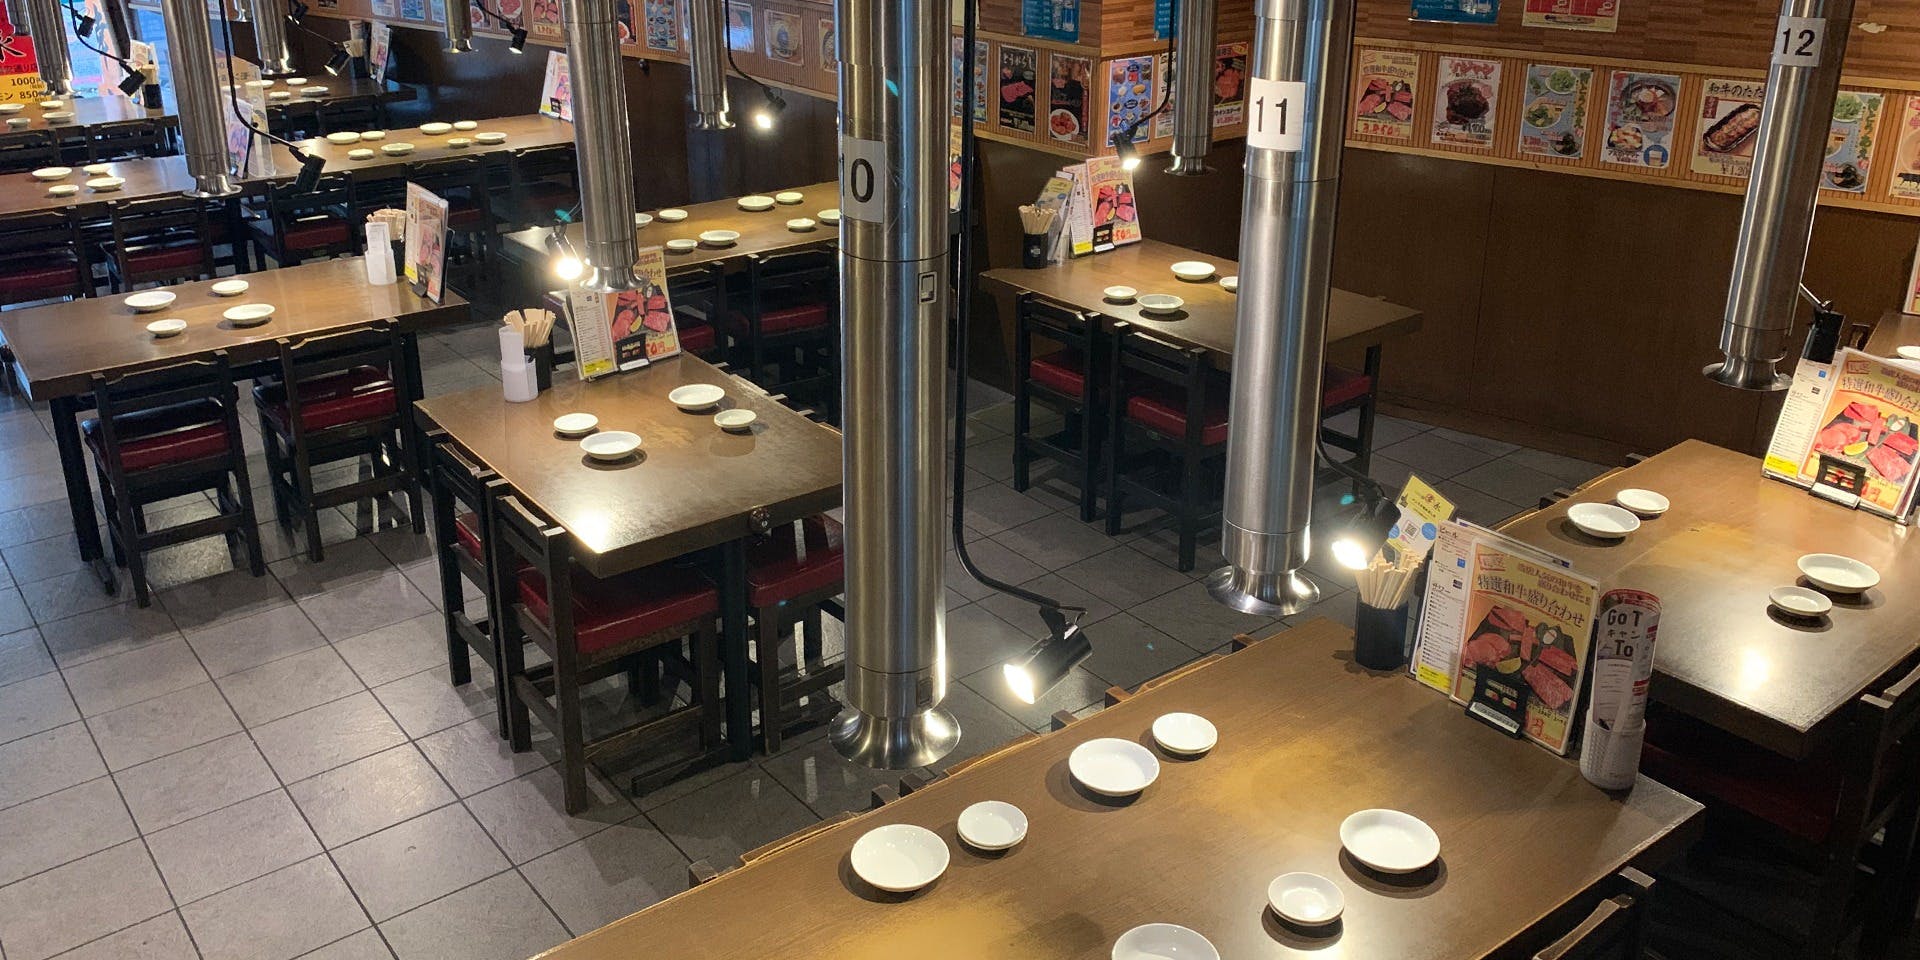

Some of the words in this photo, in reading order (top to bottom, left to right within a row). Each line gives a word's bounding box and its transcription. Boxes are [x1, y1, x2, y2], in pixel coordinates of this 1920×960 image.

[1782, 28, 1815, 57] 12
[1256, 96, 1288, 135] 11
[1478, 573, 1585, 629] 特選和牛盛り合わせ
[1607, 609, 1628, 627] Go
[1607, 629, 1641, 640] キャン
[1614, 639, 1634, 658] To
